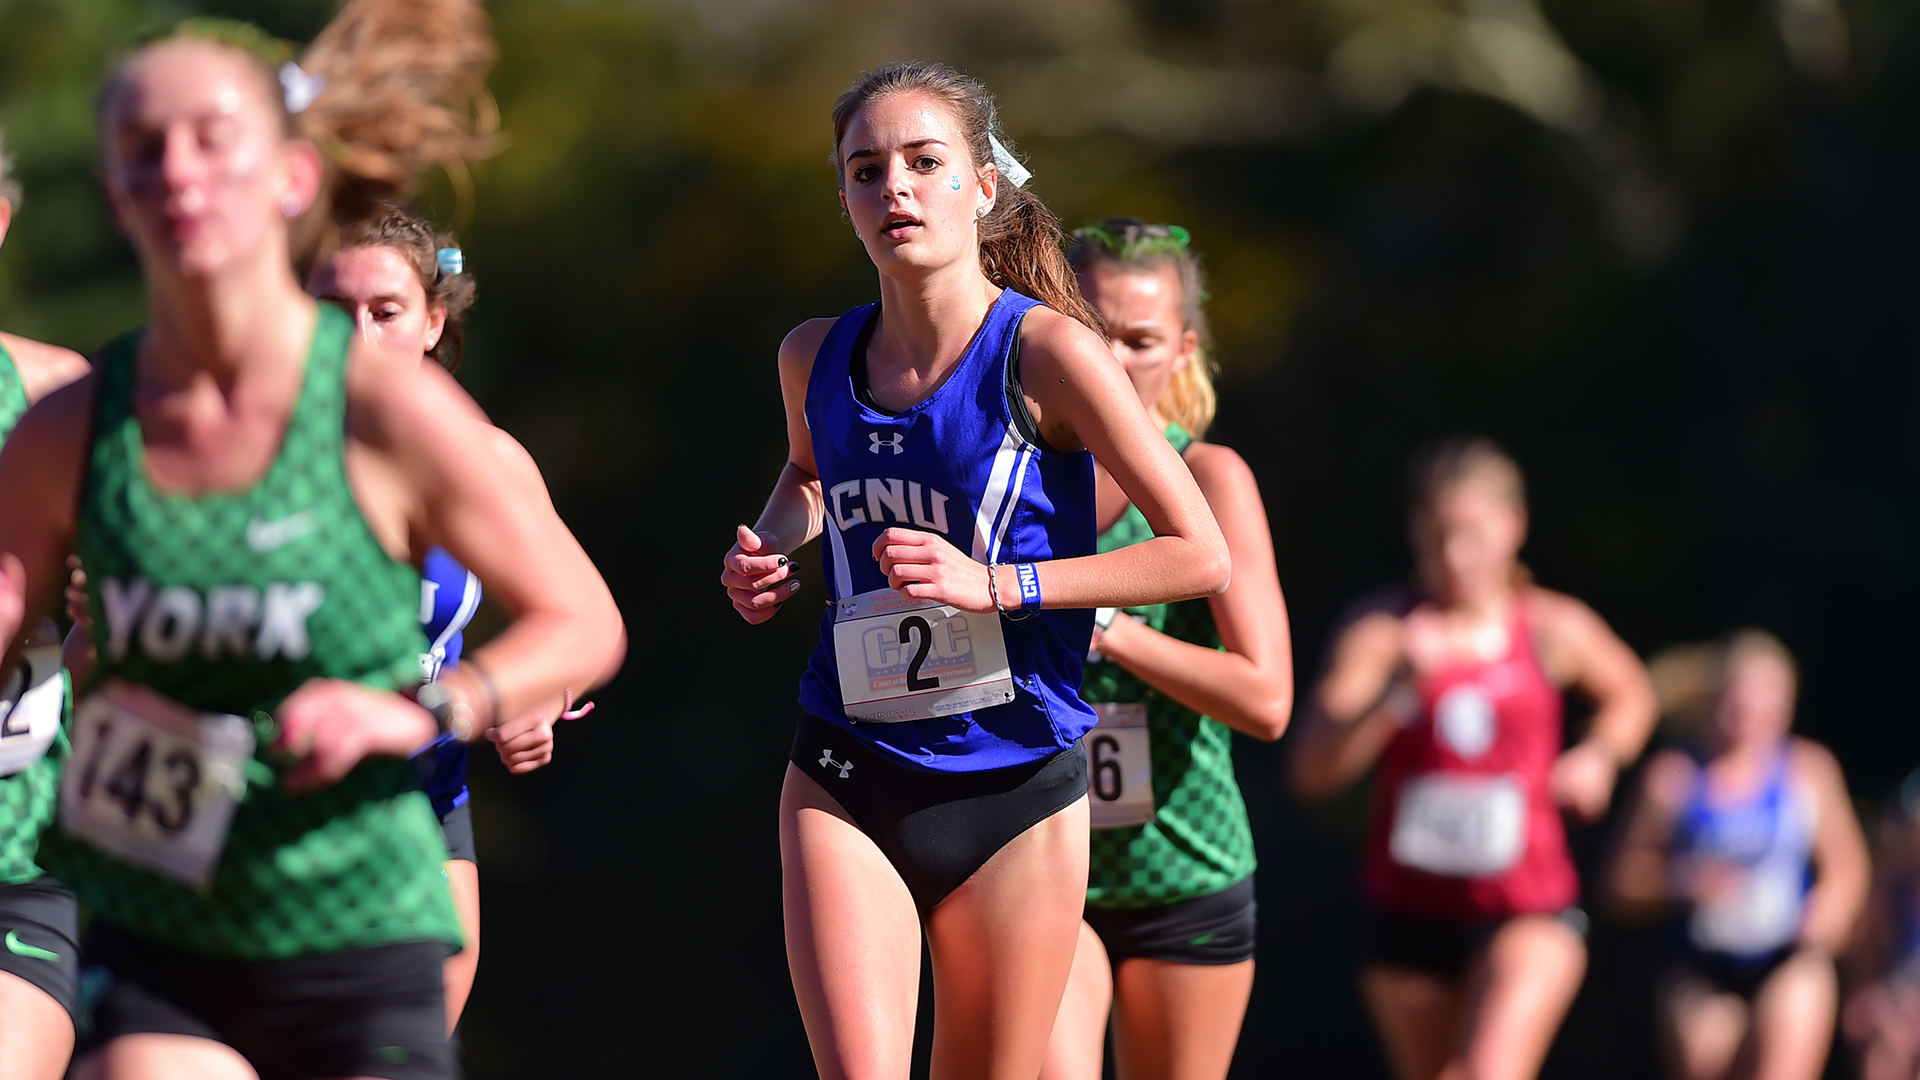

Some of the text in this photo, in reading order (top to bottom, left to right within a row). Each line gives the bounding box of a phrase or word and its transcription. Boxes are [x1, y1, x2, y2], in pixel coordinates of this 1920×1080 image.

[829, 477, 949, 535] CNU
[1018, 564, 1038, 599] CNU
[101, 577, 325, 662] YORK
[899, 615, 940, 692] 2
[78, 716, 202, 833] 143
[1092, 734, 1122, 802] 6
